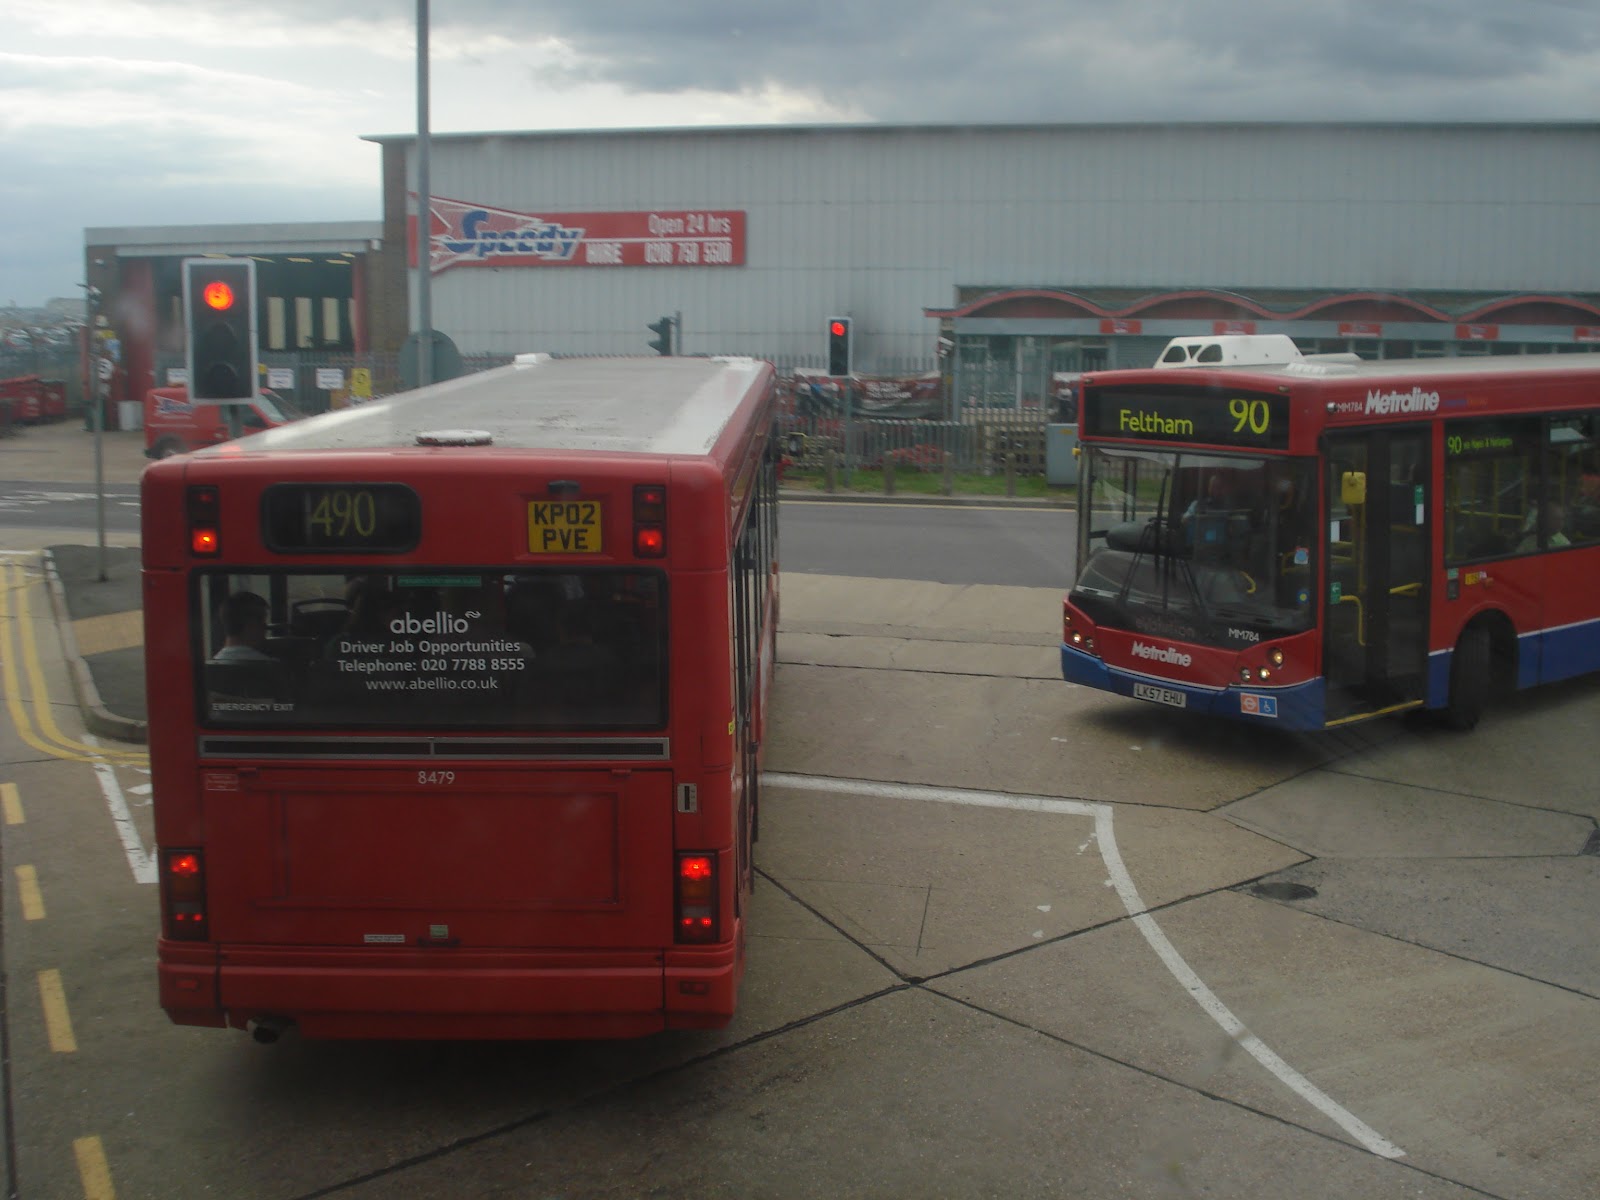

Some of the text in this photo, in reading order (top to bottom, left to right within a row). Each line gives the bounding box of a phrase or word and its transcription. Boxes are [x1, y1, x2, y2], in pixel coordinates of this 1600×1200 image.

[445, 210, 585, 259] Speedy
[649, 213, 731, 237] Open 24 hrs
[1364, 386, 1440, 415] Metroline
[1120, 399, 1270, 435] Feltham 90
[1447, 436, 1462, 455] 90
[310, 491, 376, 538] 490
[534, 503, 595, 525] KP02
[542, 529, 588, 549] PVE
[389, 611, 469, 634] abellio
[1228, 628, 1260, 641] MM784
[340, 640, 521, 656] Driver Job Opportunities
[1131, 641, 1192, 667] Metroline
[337, 658, 526, 674] Telephone: 020 7788 8555
[366, 676, 499, 690] www.abellio.co.uk
[1136, 684, 1183, 706] LK57 EHU
[212, 703, 294, 711] EMERGENCY EXIT
[418, 771, 455, 784] 8479
